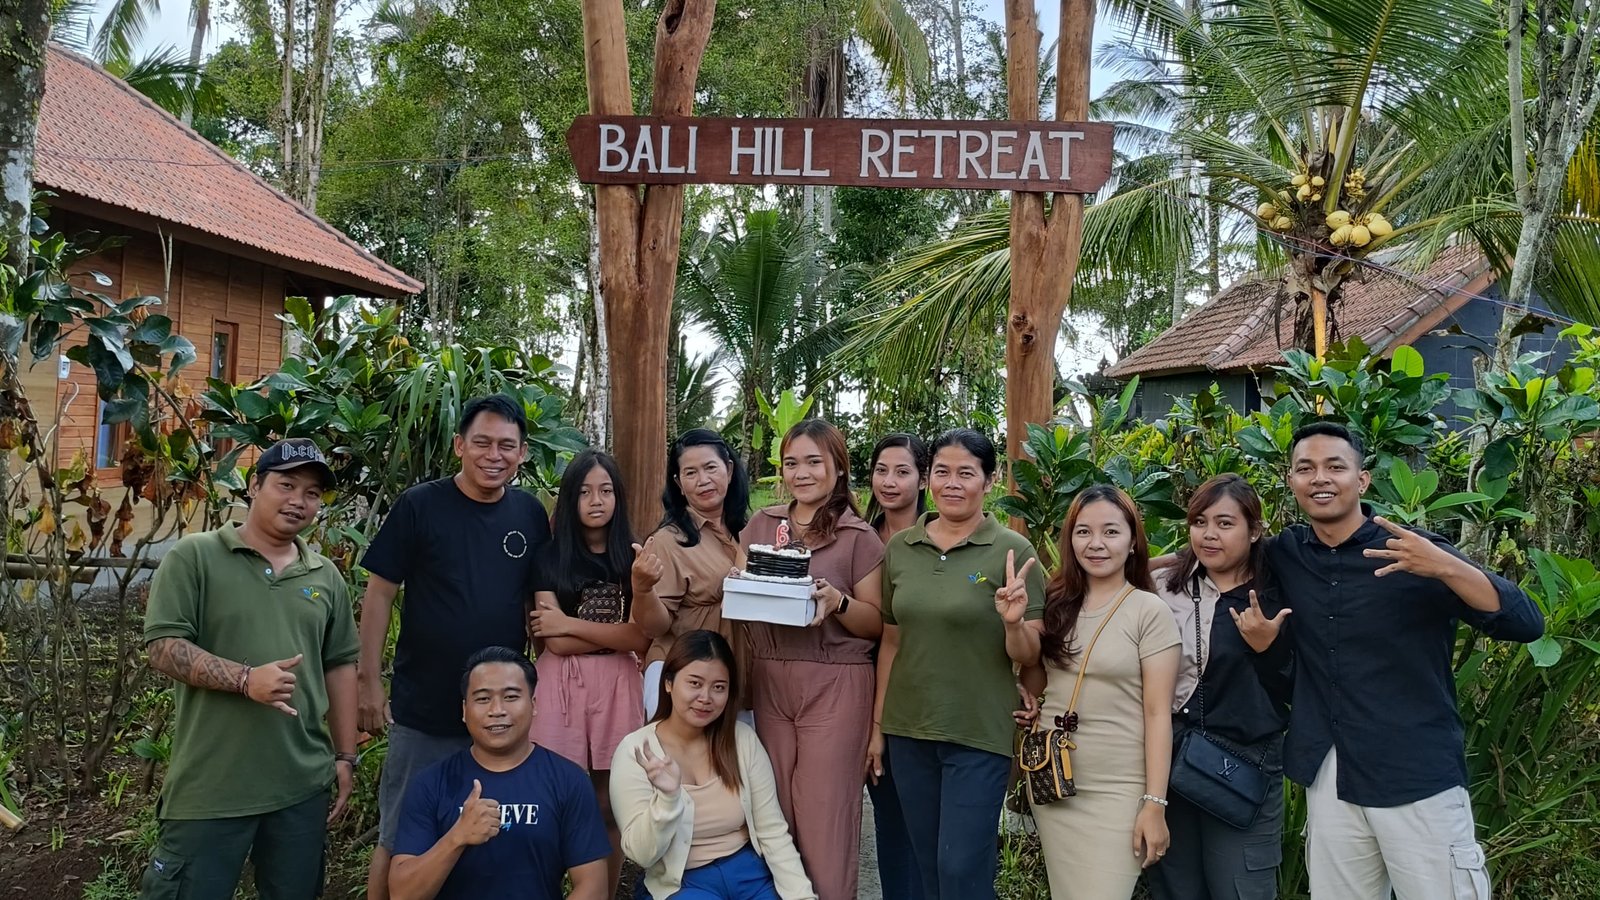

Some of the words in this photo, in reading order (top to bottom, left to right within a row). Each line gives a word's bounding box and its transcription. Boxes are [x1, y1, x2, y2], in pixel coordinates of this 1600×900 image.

[598, 123, 698, 174] BALI
[729, 126, 831, 177] HILL
[859, 128, 1085, 181] RETREAT
[776, 523, 790, 547] 6
